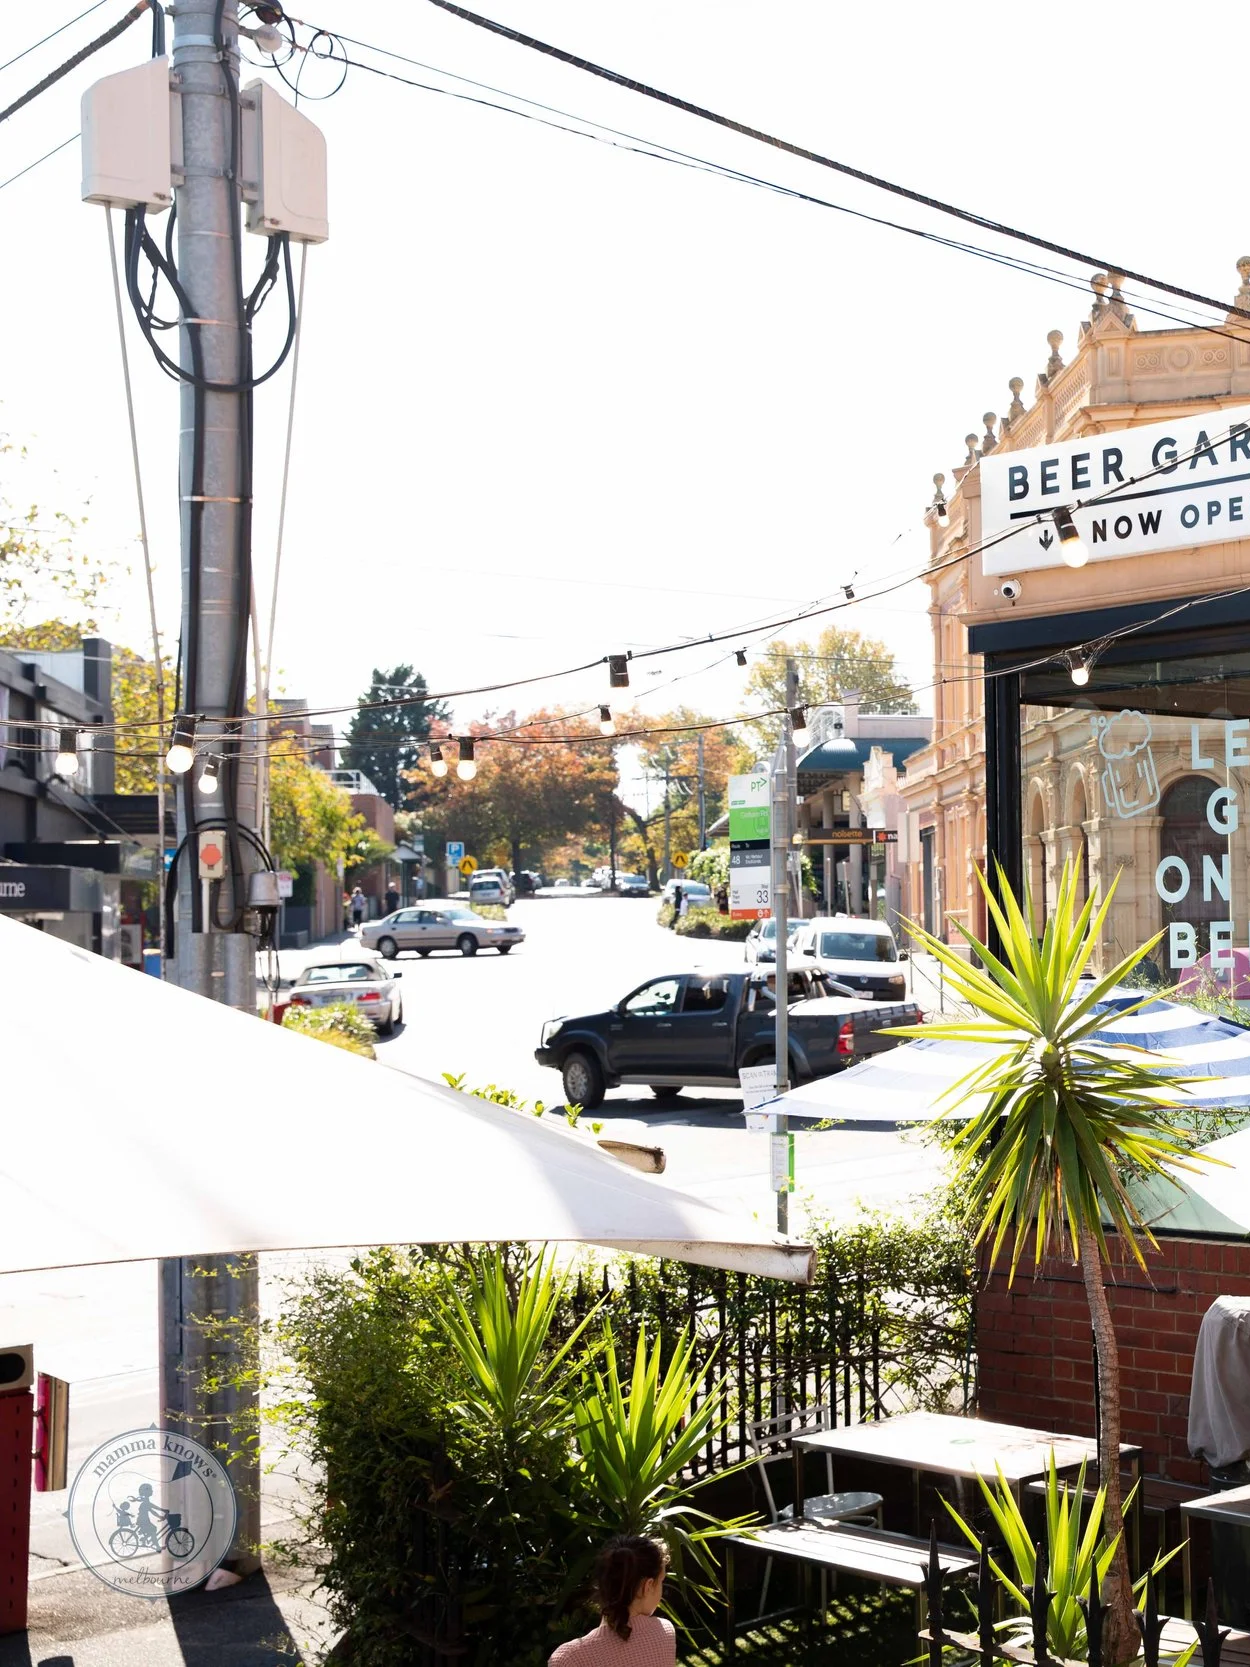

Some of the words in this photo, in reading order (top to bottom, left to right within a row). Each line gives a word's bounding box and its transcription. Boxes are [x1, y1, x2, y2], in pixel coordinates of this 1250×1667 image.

[1009, 447, 1125, 501] BEER
[1093, 510, 1163, 543] NOW
[732, 855, 741, 865] 48
[1155, 854, 1231, 903] ON
[756, 890, 769, 904] 33
